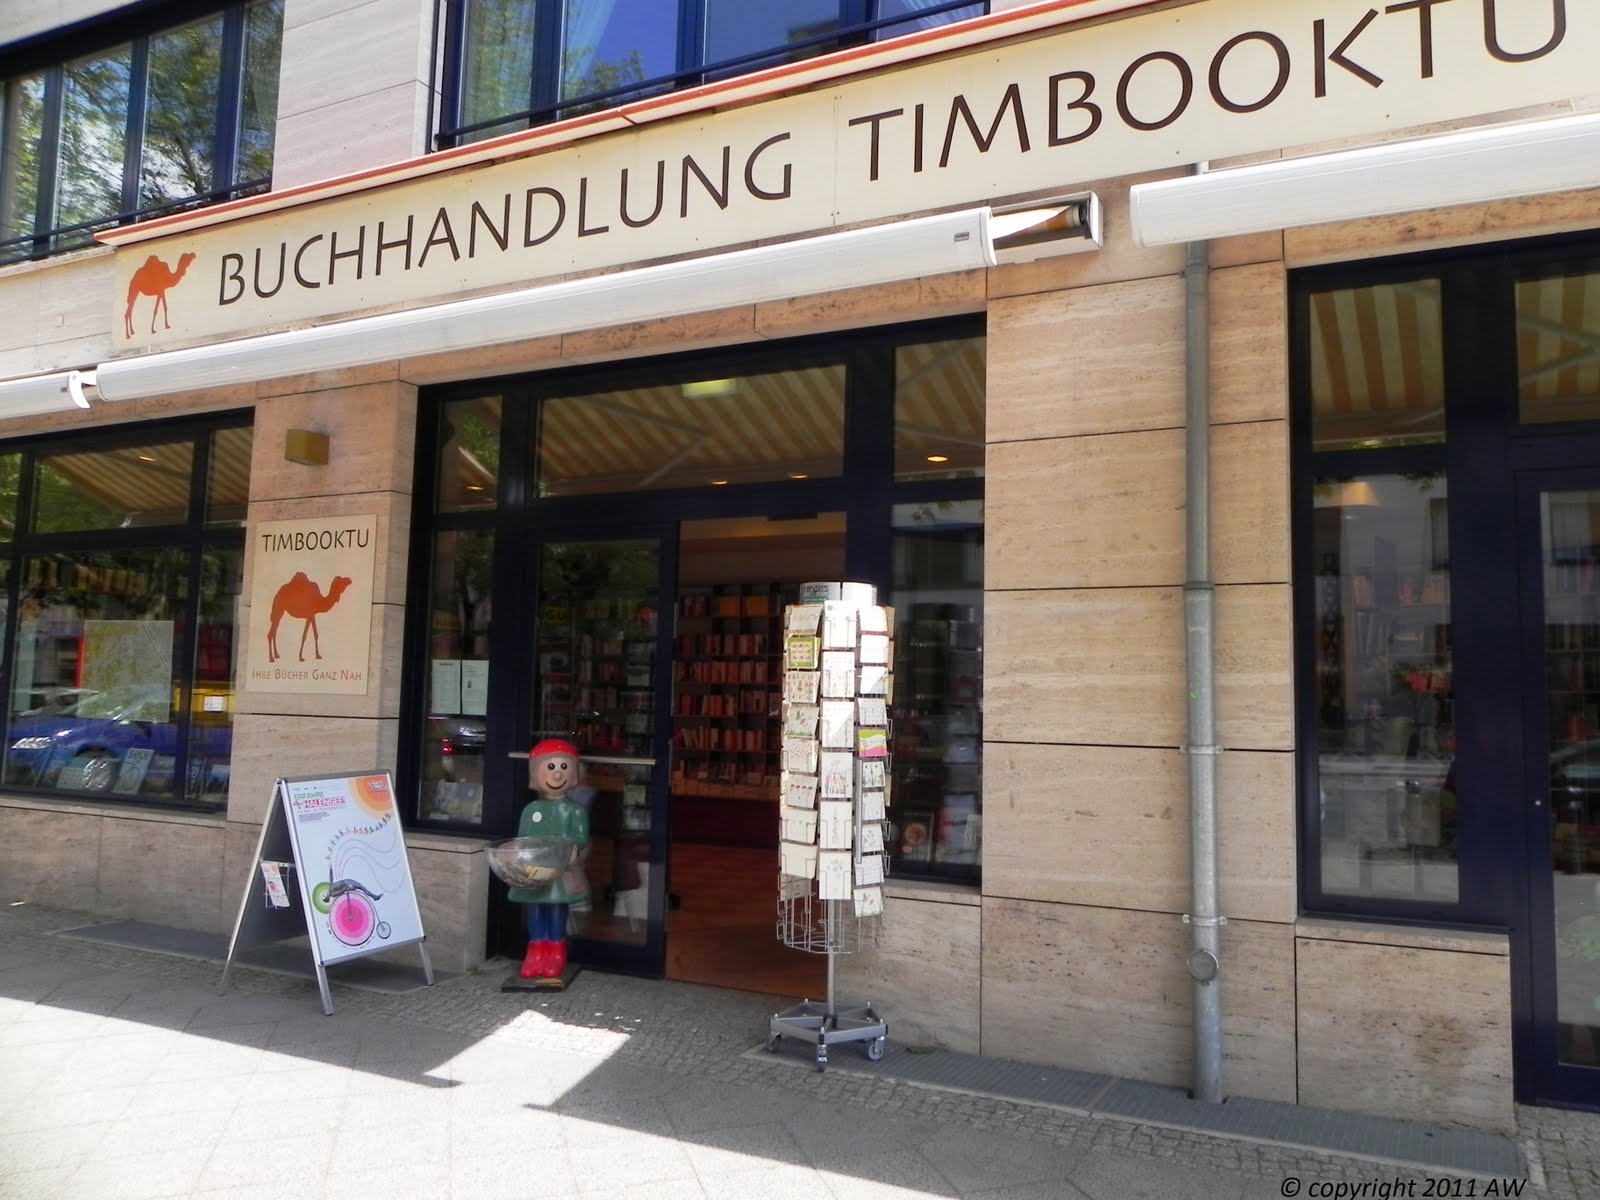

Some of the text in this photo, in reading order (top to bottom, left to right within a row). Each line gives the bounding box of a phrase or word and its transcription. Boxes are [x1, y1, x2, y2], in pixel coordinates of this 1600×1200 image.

[218, 0, 1567, 306] BUCHHANDLUNG TIMBOOKTU
[262, 528, 370, 553] TIMBOOKTU
